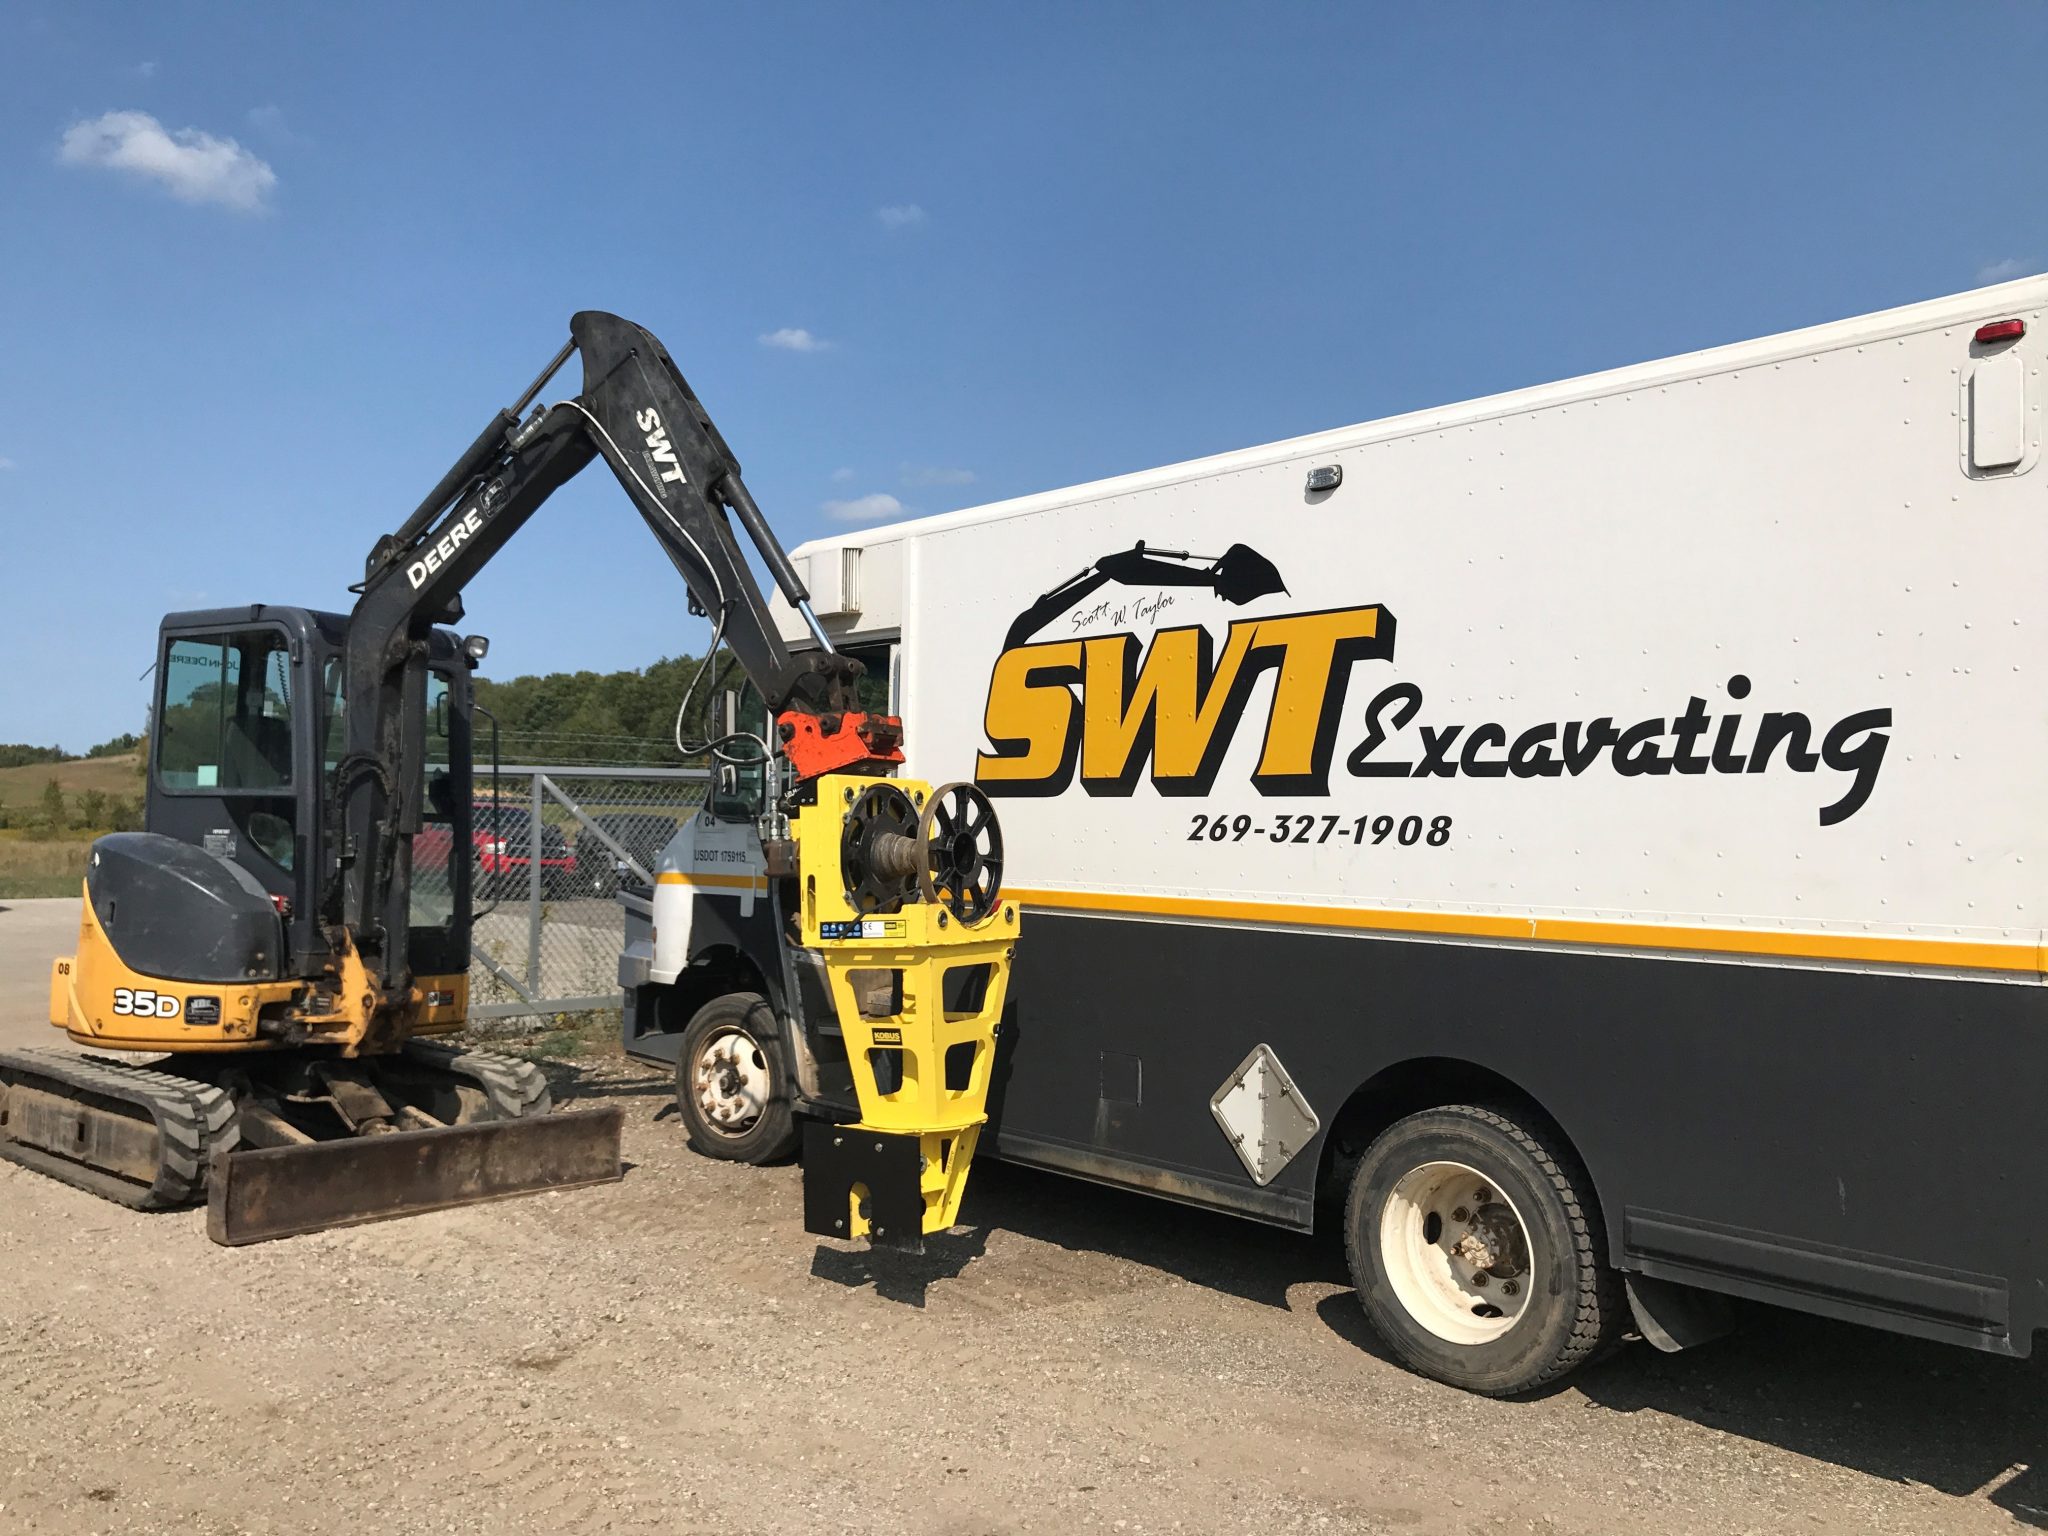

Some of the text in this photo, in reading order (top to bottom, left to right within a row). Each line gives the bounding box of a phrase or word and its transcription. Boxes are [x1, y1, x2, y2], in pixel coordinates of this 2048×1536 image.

[636, 407, 687, 484] SWT
[407, 508, 482, 590] DEERE
[1072, 601, 1110, 633] Scott
[1132, 592, 1175, 625] Taylor
[975, 604, 1893, 827] SWT Excavating
[704, 816, 716, 827] 04
[1187, 814, 1453, 847] 269-327-1908
[694, 849, 719, 862] USDOT
[58, 963, 70, 976] 08
[113, 988, 181, 1018] 35D
